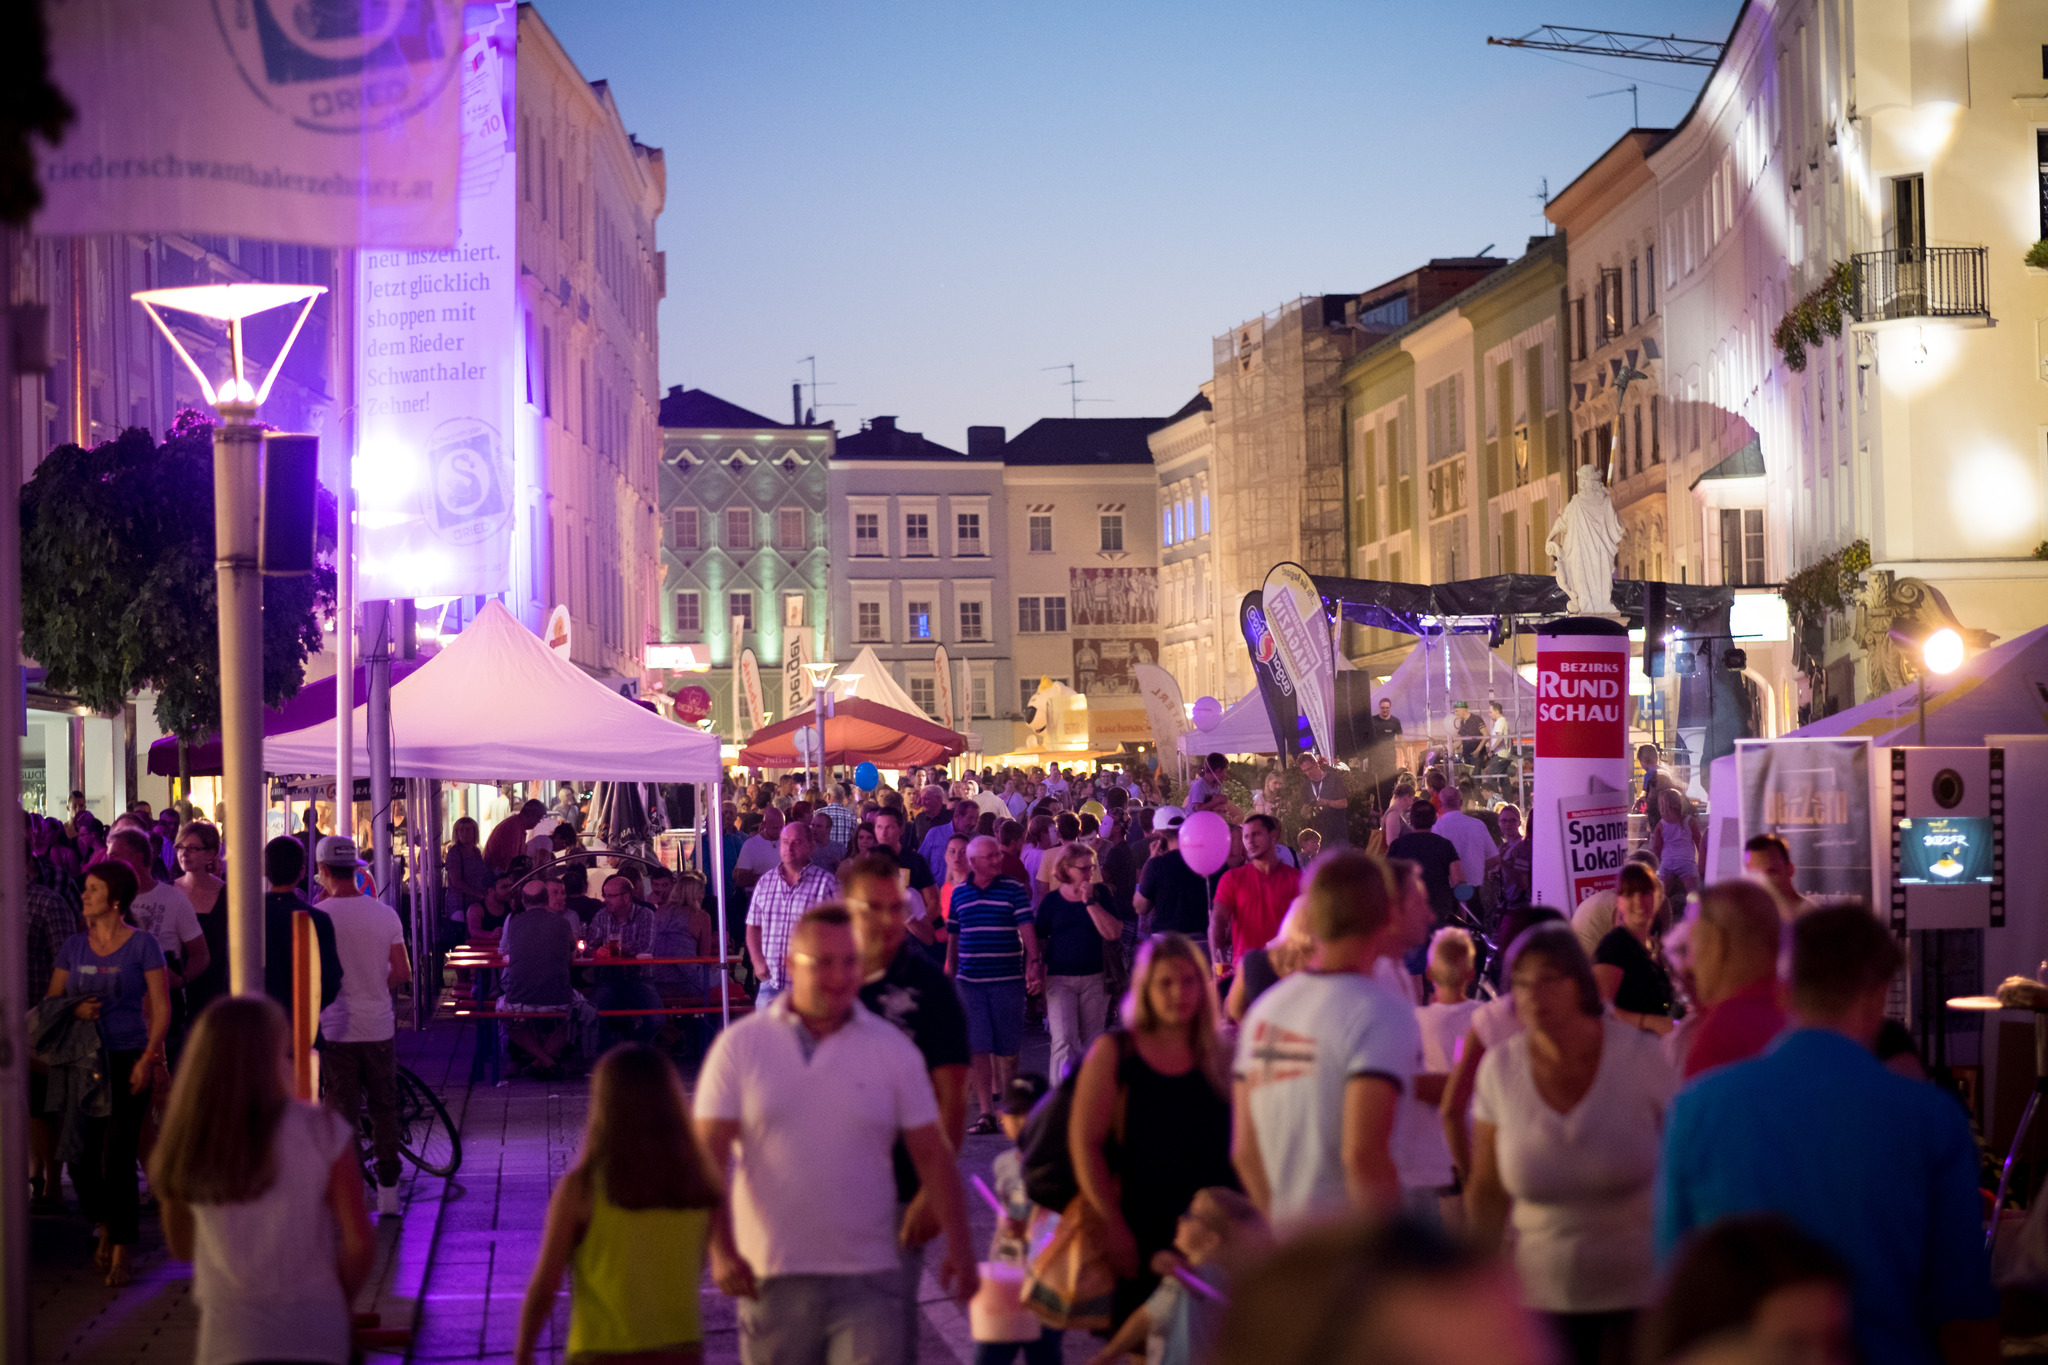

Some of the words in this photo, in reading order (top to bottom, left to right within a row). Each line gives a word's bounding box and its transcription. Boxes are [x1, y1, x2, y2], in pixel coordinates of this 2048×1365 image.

[368, 253, 400, 269] neu
[406, 243, 500, 266] inszeniert.
[368, 280, 407, 302] Jetzt
[410, 272, 491, 300] glücklich
[368, 308, 436, 331] shoppen
[441, 302, 476, 321] mit
[367, 339, 406, 357] dem
[409, 333, 465, 354] Rieder
[367, 362, 487, 387] Schwanthaler
[367, 391, 430, 417] Zehner!
[1560, 662, 1619, 673] BEZIRKS
[1540, 703, 1619, 722] SCHAU
